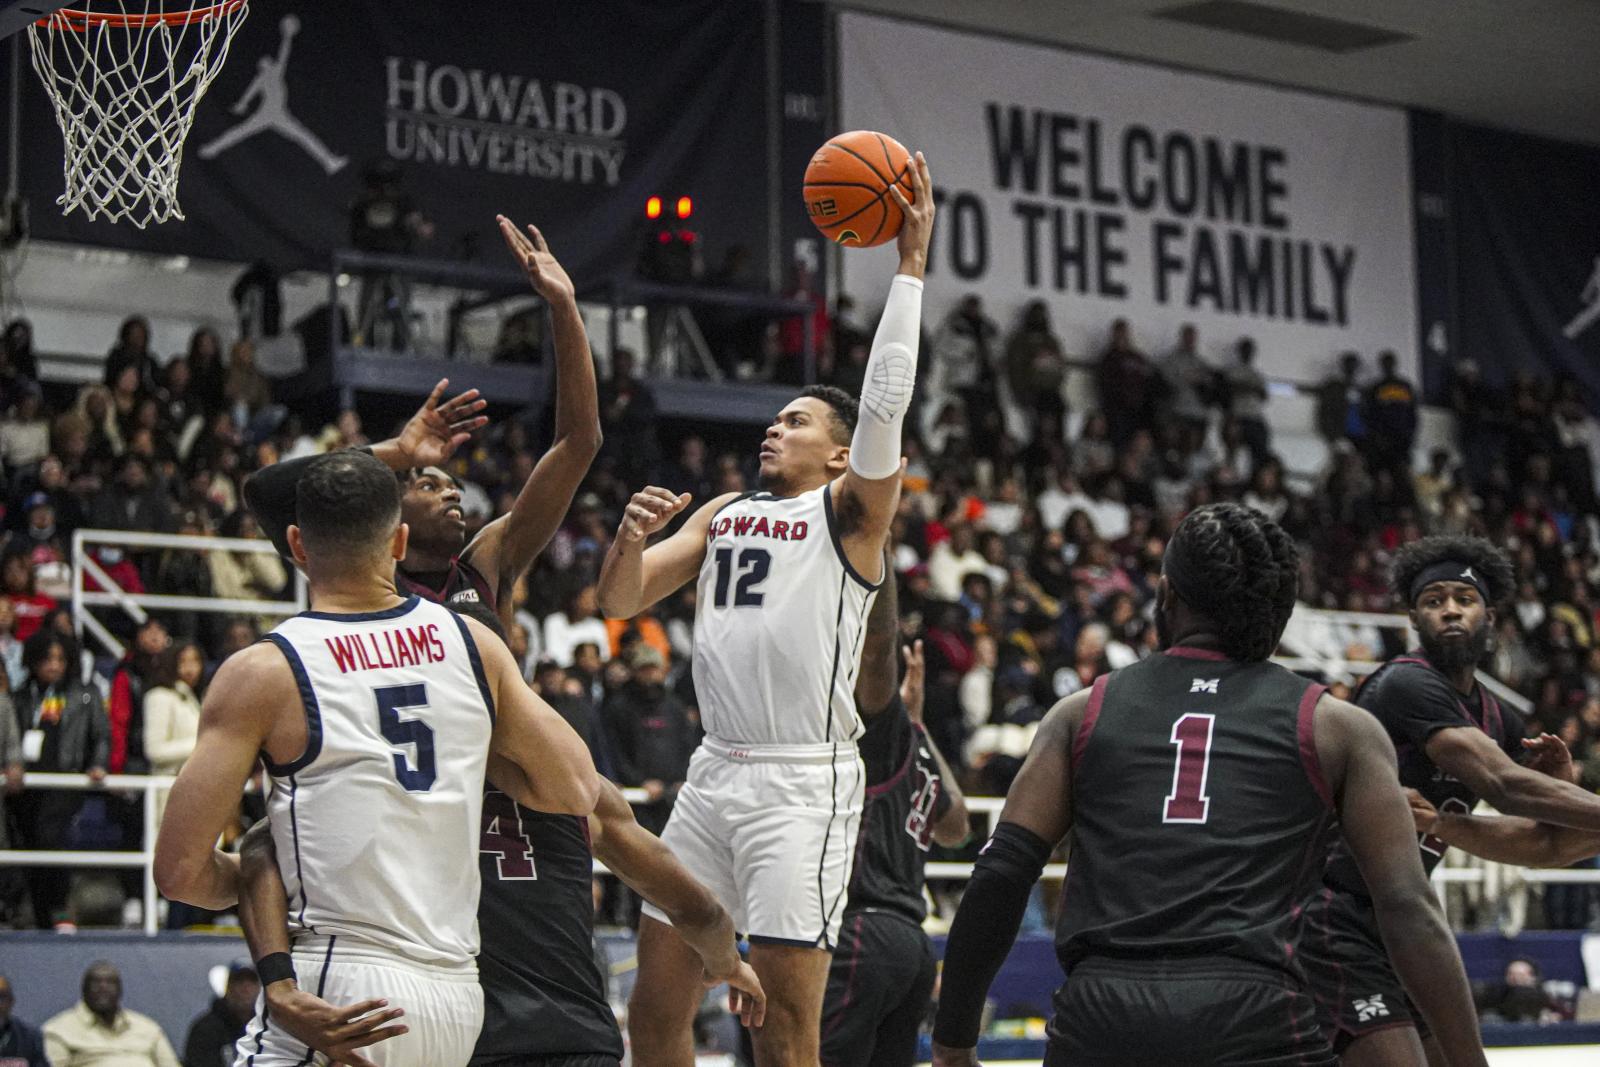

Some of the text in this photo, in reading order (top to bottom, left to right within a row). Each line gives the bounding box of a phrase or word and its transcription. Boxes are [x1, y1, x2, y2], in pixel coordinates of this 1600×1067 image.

[385, 56, 627, 137] HOWARD
[386, 119, 627, 186] UNIVERSITY
[986, 103, 1289, 230] WELCOME
[1013, 201, 1127, 298] THE
[1152, 221, 1355, 326] FAMILY
[708, 516, 808, 543] HOWARD
[714, 548, 771, 609] 12
[324, 623, 446, 674] WILLIAMS
[372, 681, 437, 793] 5
[1162, 712, 1216, 824] 1
